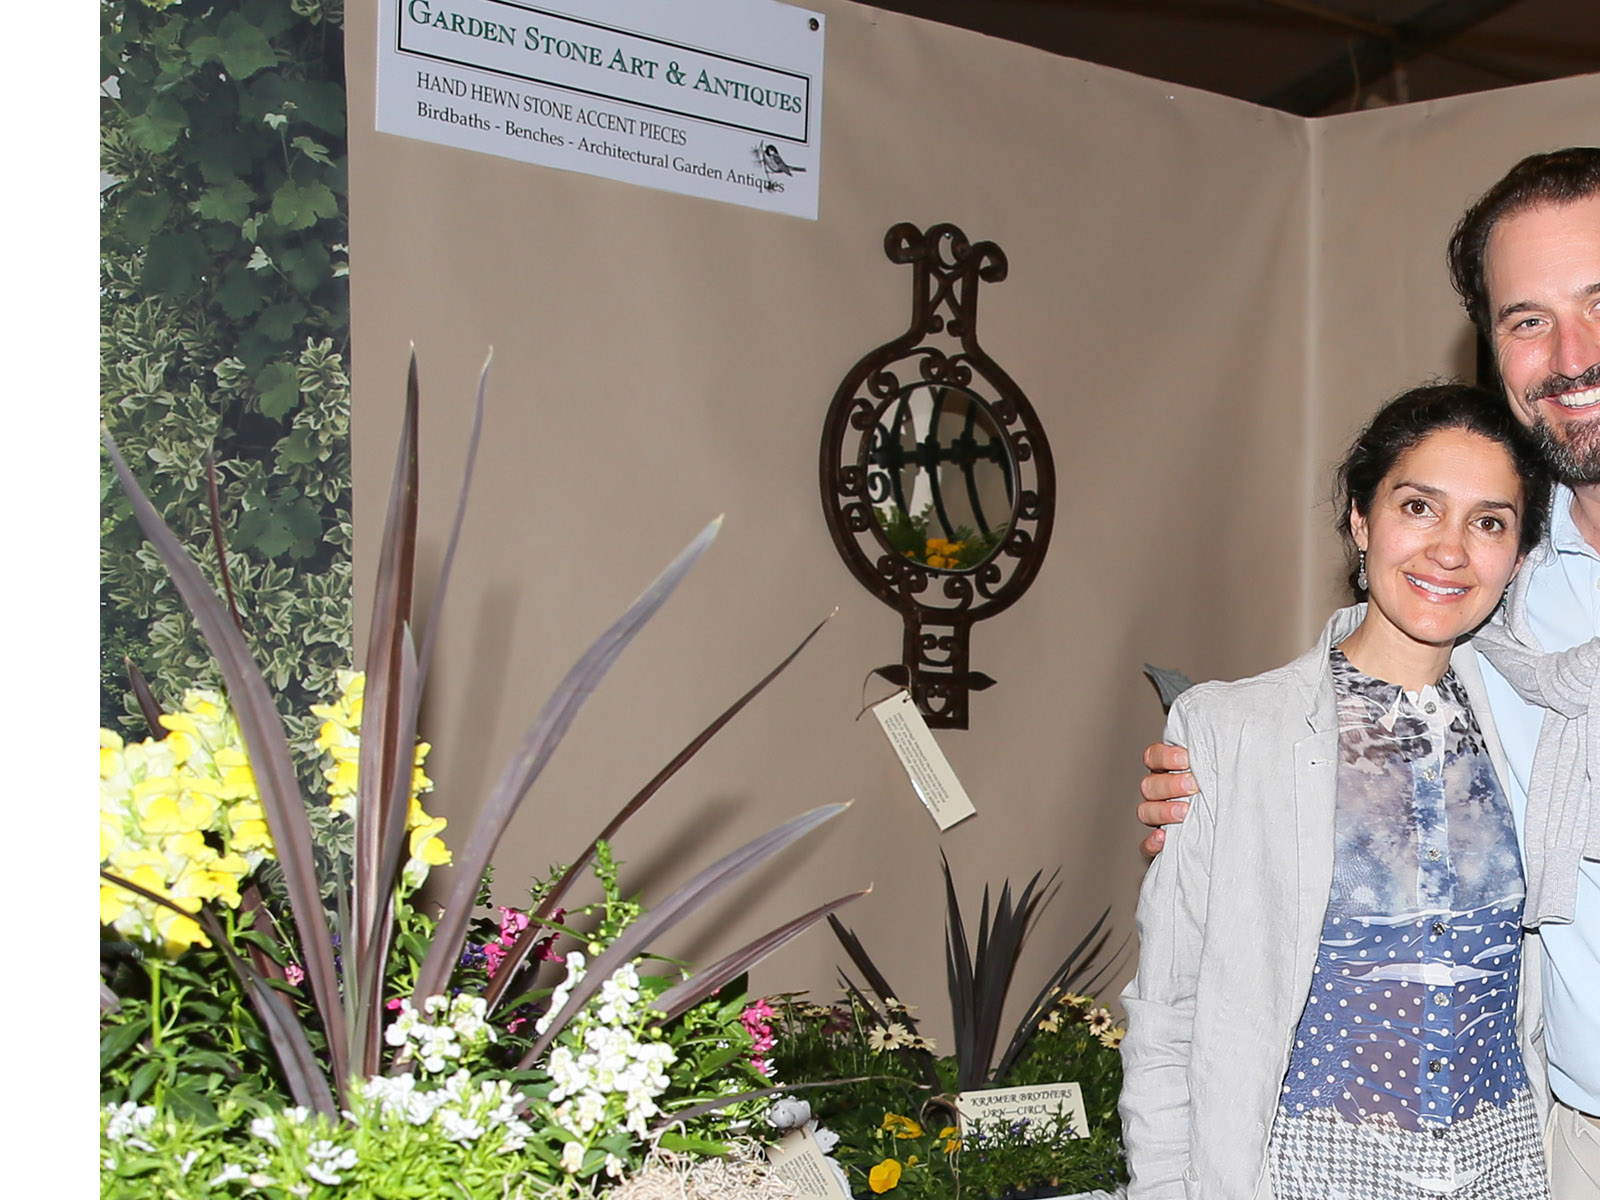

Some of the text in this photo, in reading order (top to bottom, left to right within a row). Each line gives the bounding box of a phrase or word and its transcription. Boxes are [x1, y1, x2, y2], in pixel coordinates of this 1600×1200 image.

[408, 0, 802, 114] GARDEN STONE ART & ANTIQUES
[417, 71, 687, 146] HAND HEWN STONE ACCENT PIECES
[417, 101, 491, 131] Birdbaths
[505, 120, 564, 148] Benches
[577, 137, 669, 169] Architectural
[672, 156, 723, 180] Garden
[726, 168, 785, 194] Antiques
[971, 1089, 1073, 1107] KRAMER BROTHERS
